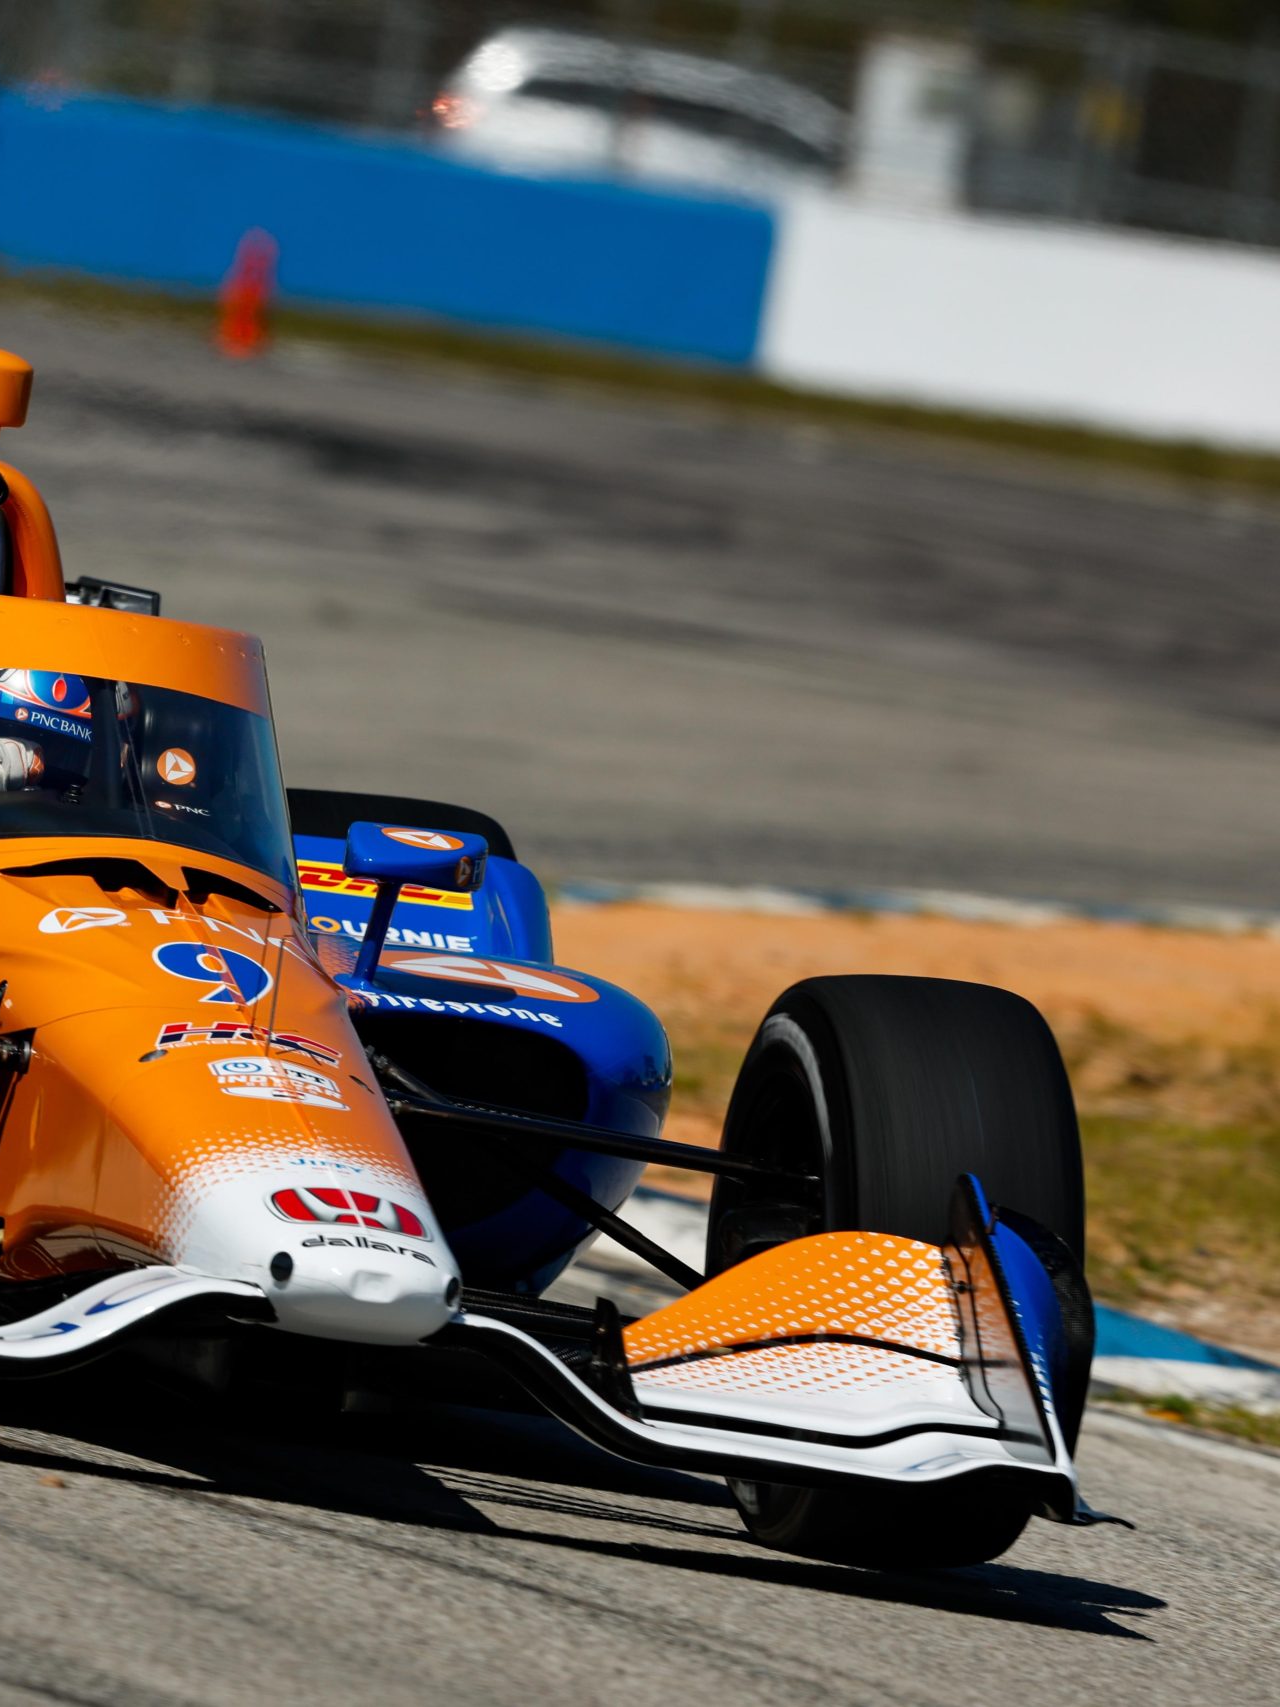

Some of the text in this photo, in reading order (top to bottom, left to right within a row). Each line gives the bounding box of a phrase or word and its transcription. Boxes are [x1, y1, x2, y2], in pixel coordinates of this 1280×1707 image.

[31, 711, 93, 742] PNC BANK
[152, 941, 273, 1006] 9
[352, 988, 563, 1027] Firestone
[302, 1235, 436, 1268] dallara
